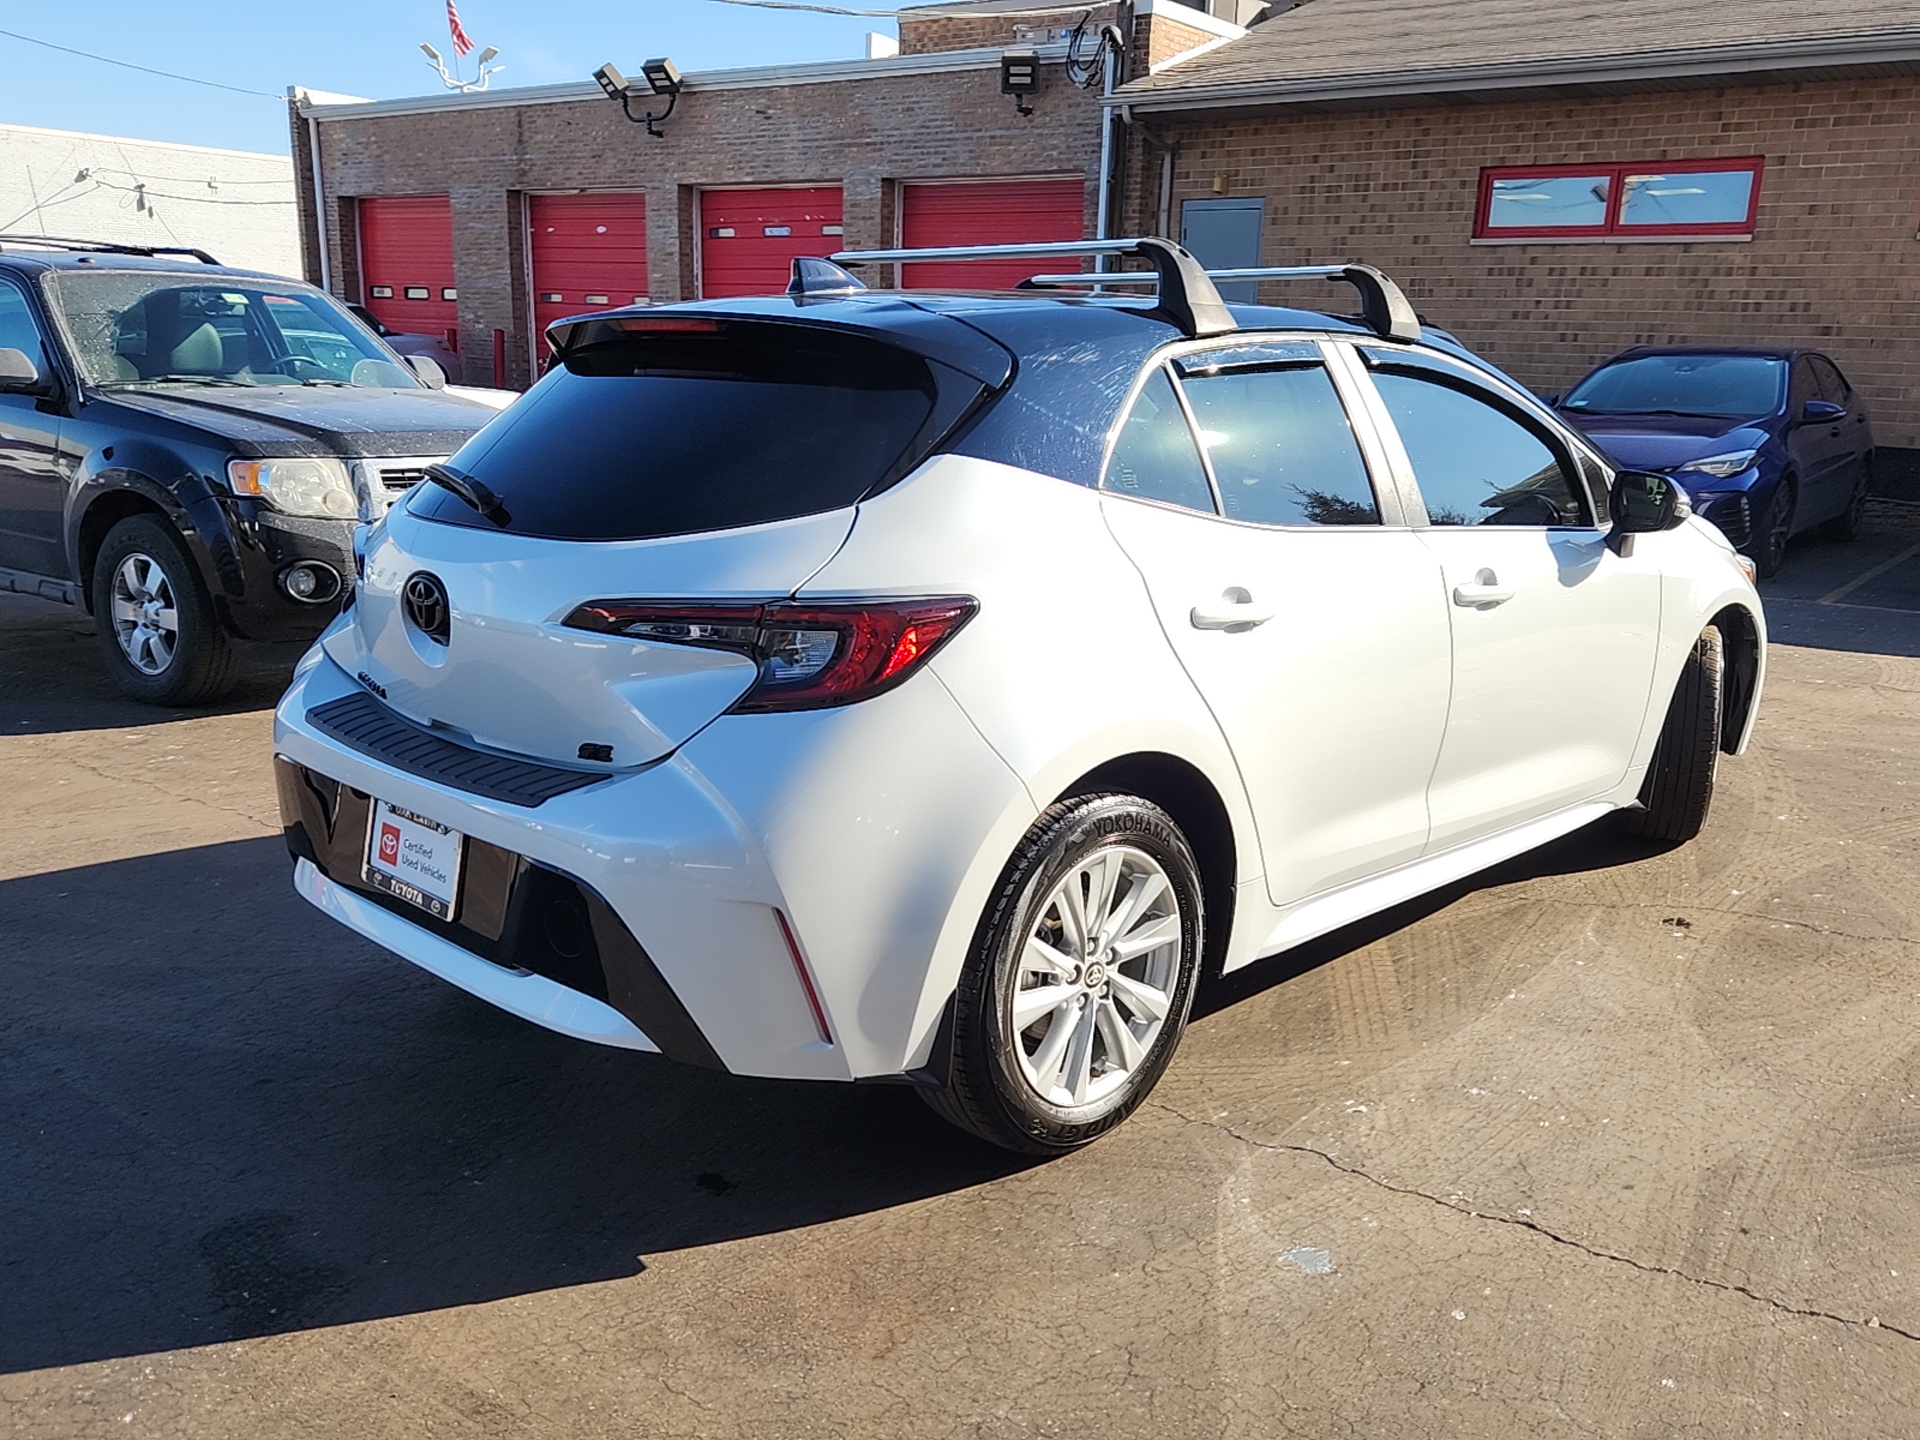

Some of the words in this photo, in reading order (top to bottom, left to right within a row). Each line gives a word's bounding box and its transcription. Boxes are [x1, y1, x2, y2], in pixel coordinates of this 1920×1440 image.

[1092, 812, 1172, 849] YOKOHAMA
[403, 838, 434, 860] Certified
[401, 852, 419, 872] Used
[420, 861, 447, 884] Vehicles
[389, 879, 424, 906] TOYOTA
